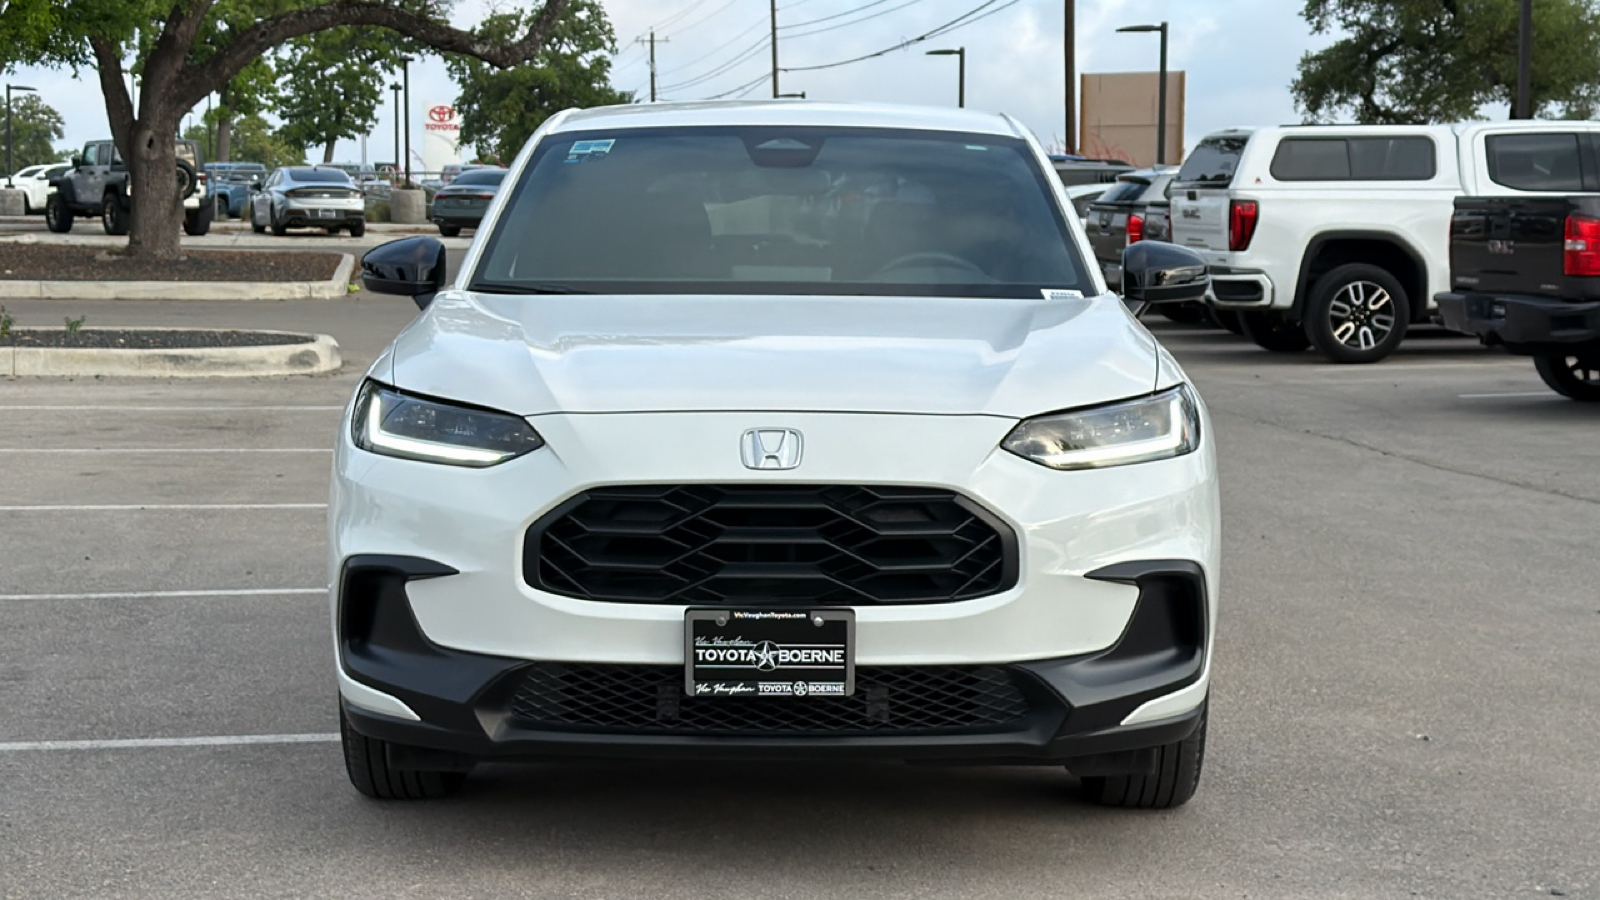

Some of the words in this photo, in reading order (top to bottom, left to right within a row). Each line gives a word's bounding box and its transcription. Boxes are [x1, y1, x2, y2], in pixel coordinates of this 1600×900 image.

[733, 611, 807, 619] VicVaughanToyota.com
[695, 649, 757, 661] TOYOTA
[779, 650, 845, 662] BOERNE
[758, 684, 793, 692] TOYOTA
[808, 684, 845, 692] BOERNE
